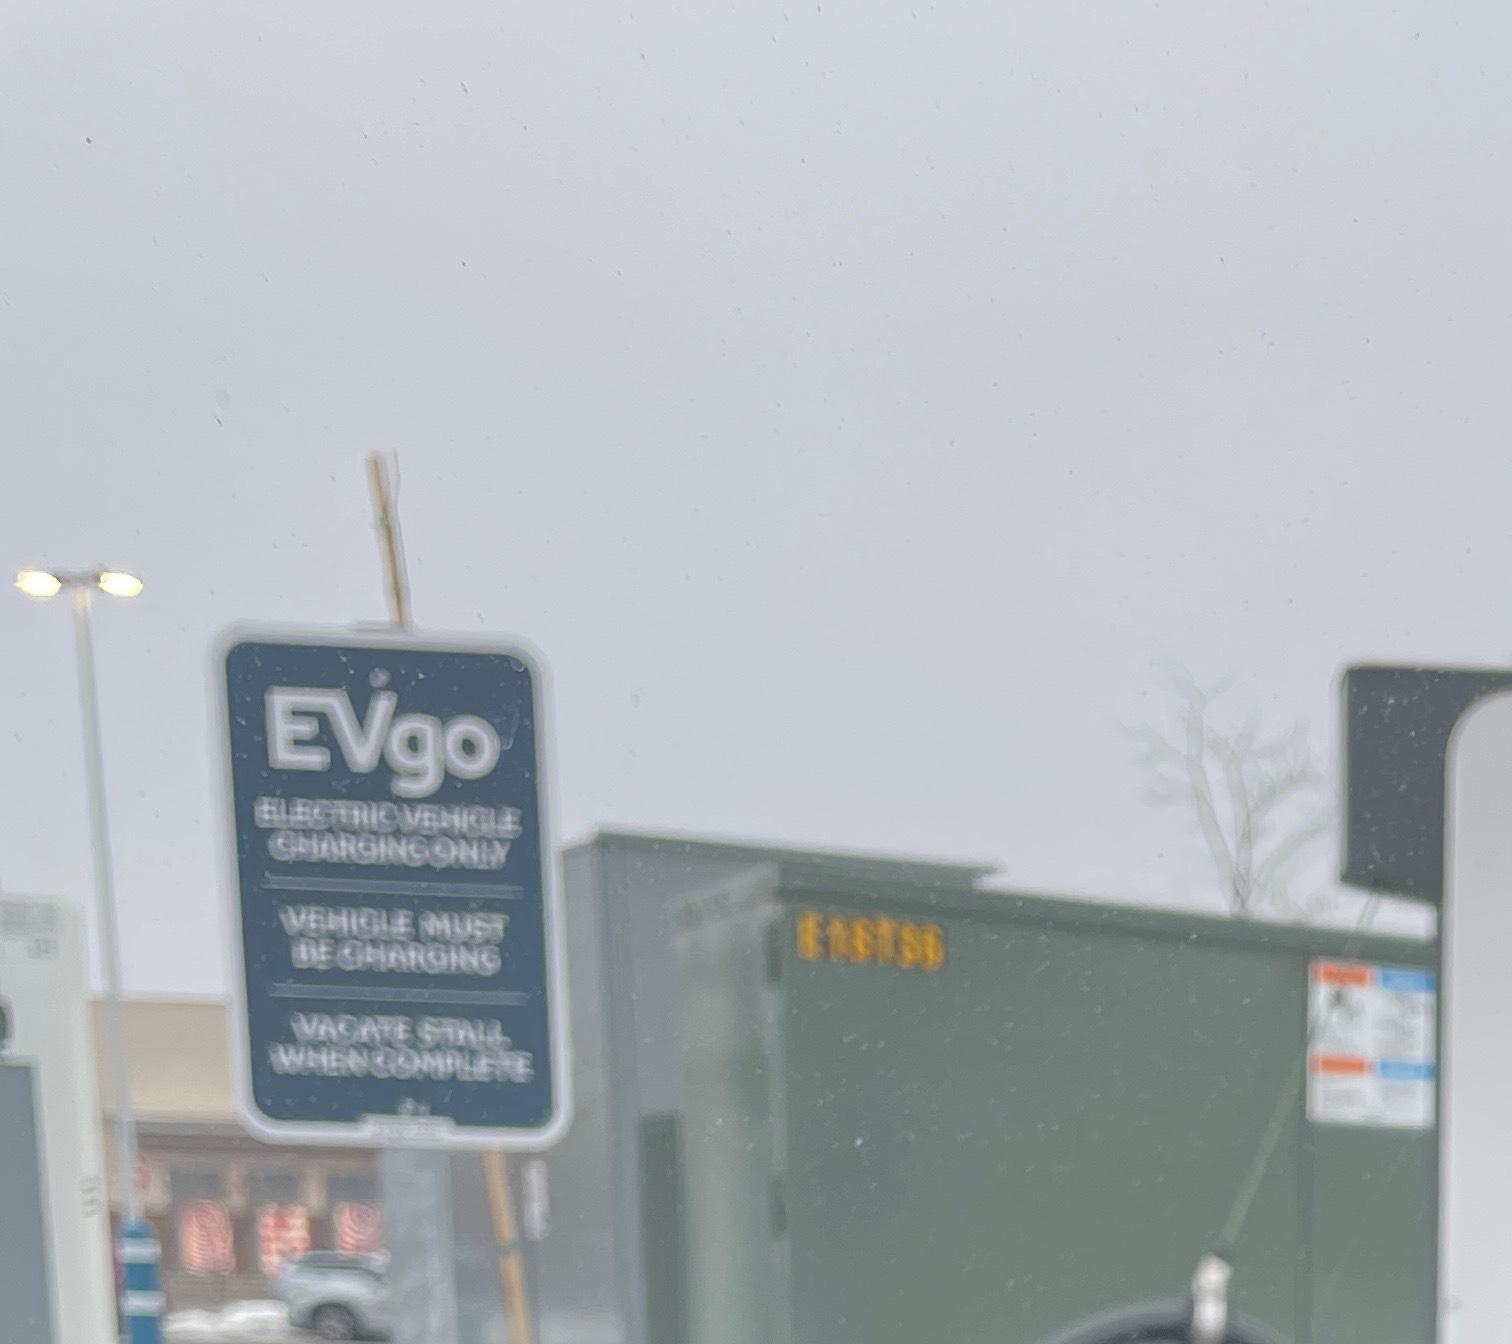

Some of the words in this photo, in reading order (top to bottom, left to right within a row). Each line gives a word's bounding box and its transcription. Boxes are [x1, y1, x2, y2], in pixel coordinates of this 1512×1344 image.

[264, 685, 500, 798] EVgo
[254, 796, 401, 833] ELECTRIC
[401, 802, 522, 839] VEHICLE
[268, 830, 428, 868] CHARGING
[428, 836, 511, 869] ONLY
[279, 905, 415, 940] VEHICLE
[418, 910, 510, 945] MUST
[291, 937, 335, 970] BE
[336, 938, 501, 976] CHARGING
[290, 1012, 413, 1045] VACATE
[416, 1016, 512, 1050] STALL
[268, 1042, 368, 1077] WHEN
[369, 1047, 535, 1083] COMPLETE
